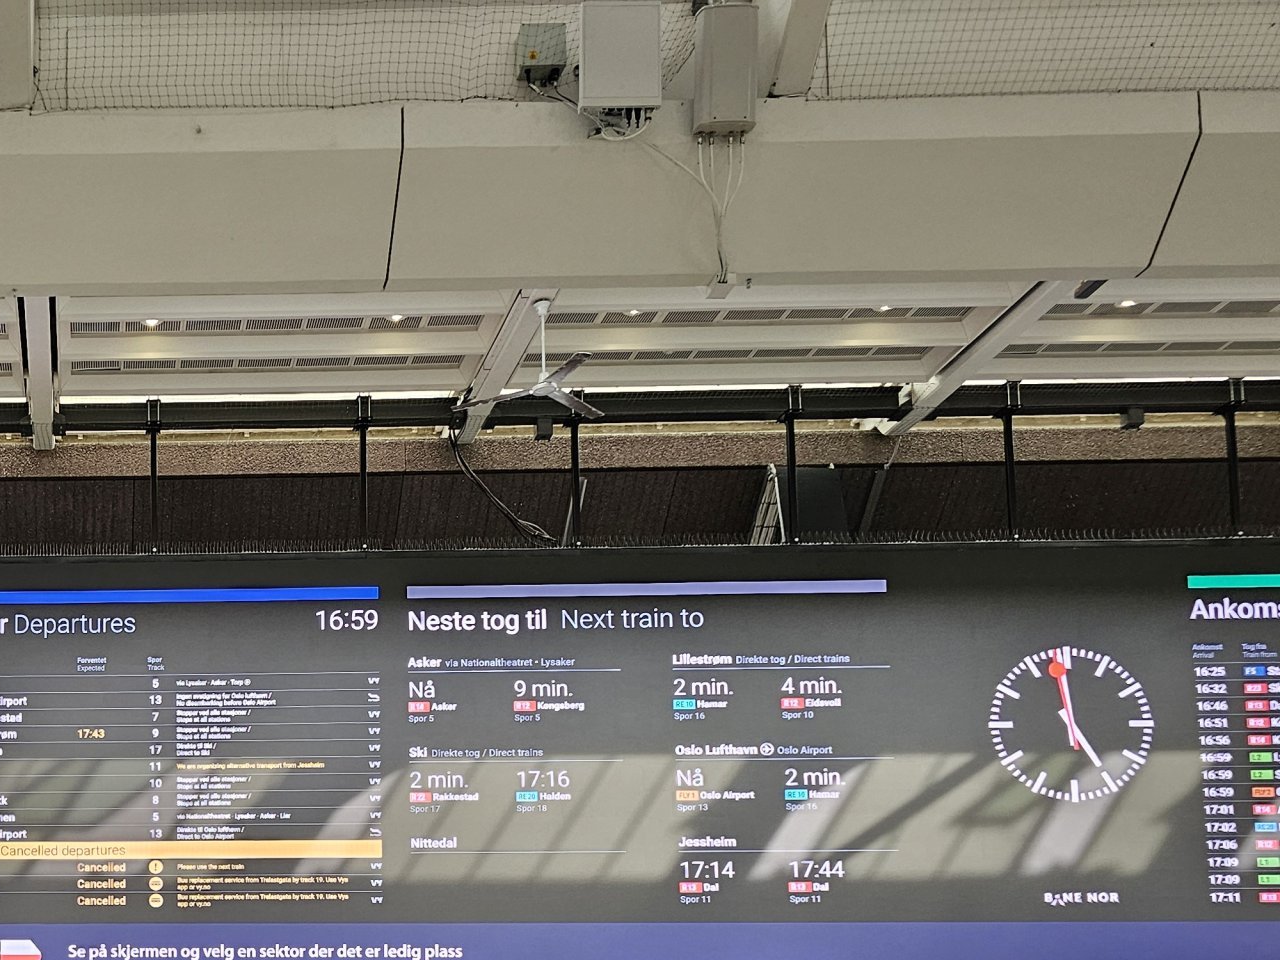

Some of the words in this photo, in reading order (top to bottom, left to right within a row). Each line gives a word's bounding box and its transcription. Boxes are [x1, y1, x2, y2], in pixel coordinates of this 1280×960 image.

[14, 613, 136, 638] Departures
[315, 609, 378, 631] 16:59
[408, 610, 476, 631] Neste
[481, 612, 520, 634] tog
[525, 609, 547, 630] til
[561, 609, 615, 629] Next
[621, 609, 674, 629] train
[679, 610, 705, 628] to
[408, 657, 442, 668] Asker
[445, 659, 458, 667] via
[460, 658, 533, 667] Nationaltheatret
[540, 658, 575, 668] Lysaker
[672, 654, 732, 666] Lillestrøm
[736, 655, 768, 664] Direkte
[770, 656, 785, 666] tog
[794, 655, 822, 664] Direct
[824, 654, 850, 664] trains
[408, 680, 436, 699] Nå
[514, 680, 526, 697] 9
[532, 680, 574, 697] min.
[674, 678, 686, 696] 2
[692, 678, 734, 696] min.
[781, 677, 796, 694] 4
[800, 676, 842, 694] min.
[409, 746, 428, 758] Ski
[432, 749, 464, 758] Direkte
[465, 750, 480, 759] tog
[489, 748, 516, 757] Direct
[517, 748, 544, 757] trains
[675, 744, 702, 756] Oslo
[706, 744, 758, 756] Lufthavn
[777, 746, 798, 755] Oslo
[800, 746, 832, 756] Airport
[410, 771, 422, 789] 2
[428, 771, 469, 788] min.
[517, 770, 570, 788] 17:16
[676, 766, 704, 787] Nå
[784, 768, 798, 786] 2
[802, 766, 846, 786] min.
[410, 837, 458, 849] Nittedal
[678, 836, 737, 848] Jessheim
[0, 845, 58, 856] Cancelled
[62, 845, 126, 858] departures
[680, 861, 736, 878] 17:14
[788, 860, 845, 878] 17:44
[77, 879, 126, 889] Cancelled
[1087, 892, 1119, 902] NOR
[68, 945, 85, 960] Se
[237, 948, 256, 960] en
[258, 944, 305, 960] sektor
[308, 944, 335, 960] der
[337, 944, 364, 960] det
[366, 948, 382, 960] er
